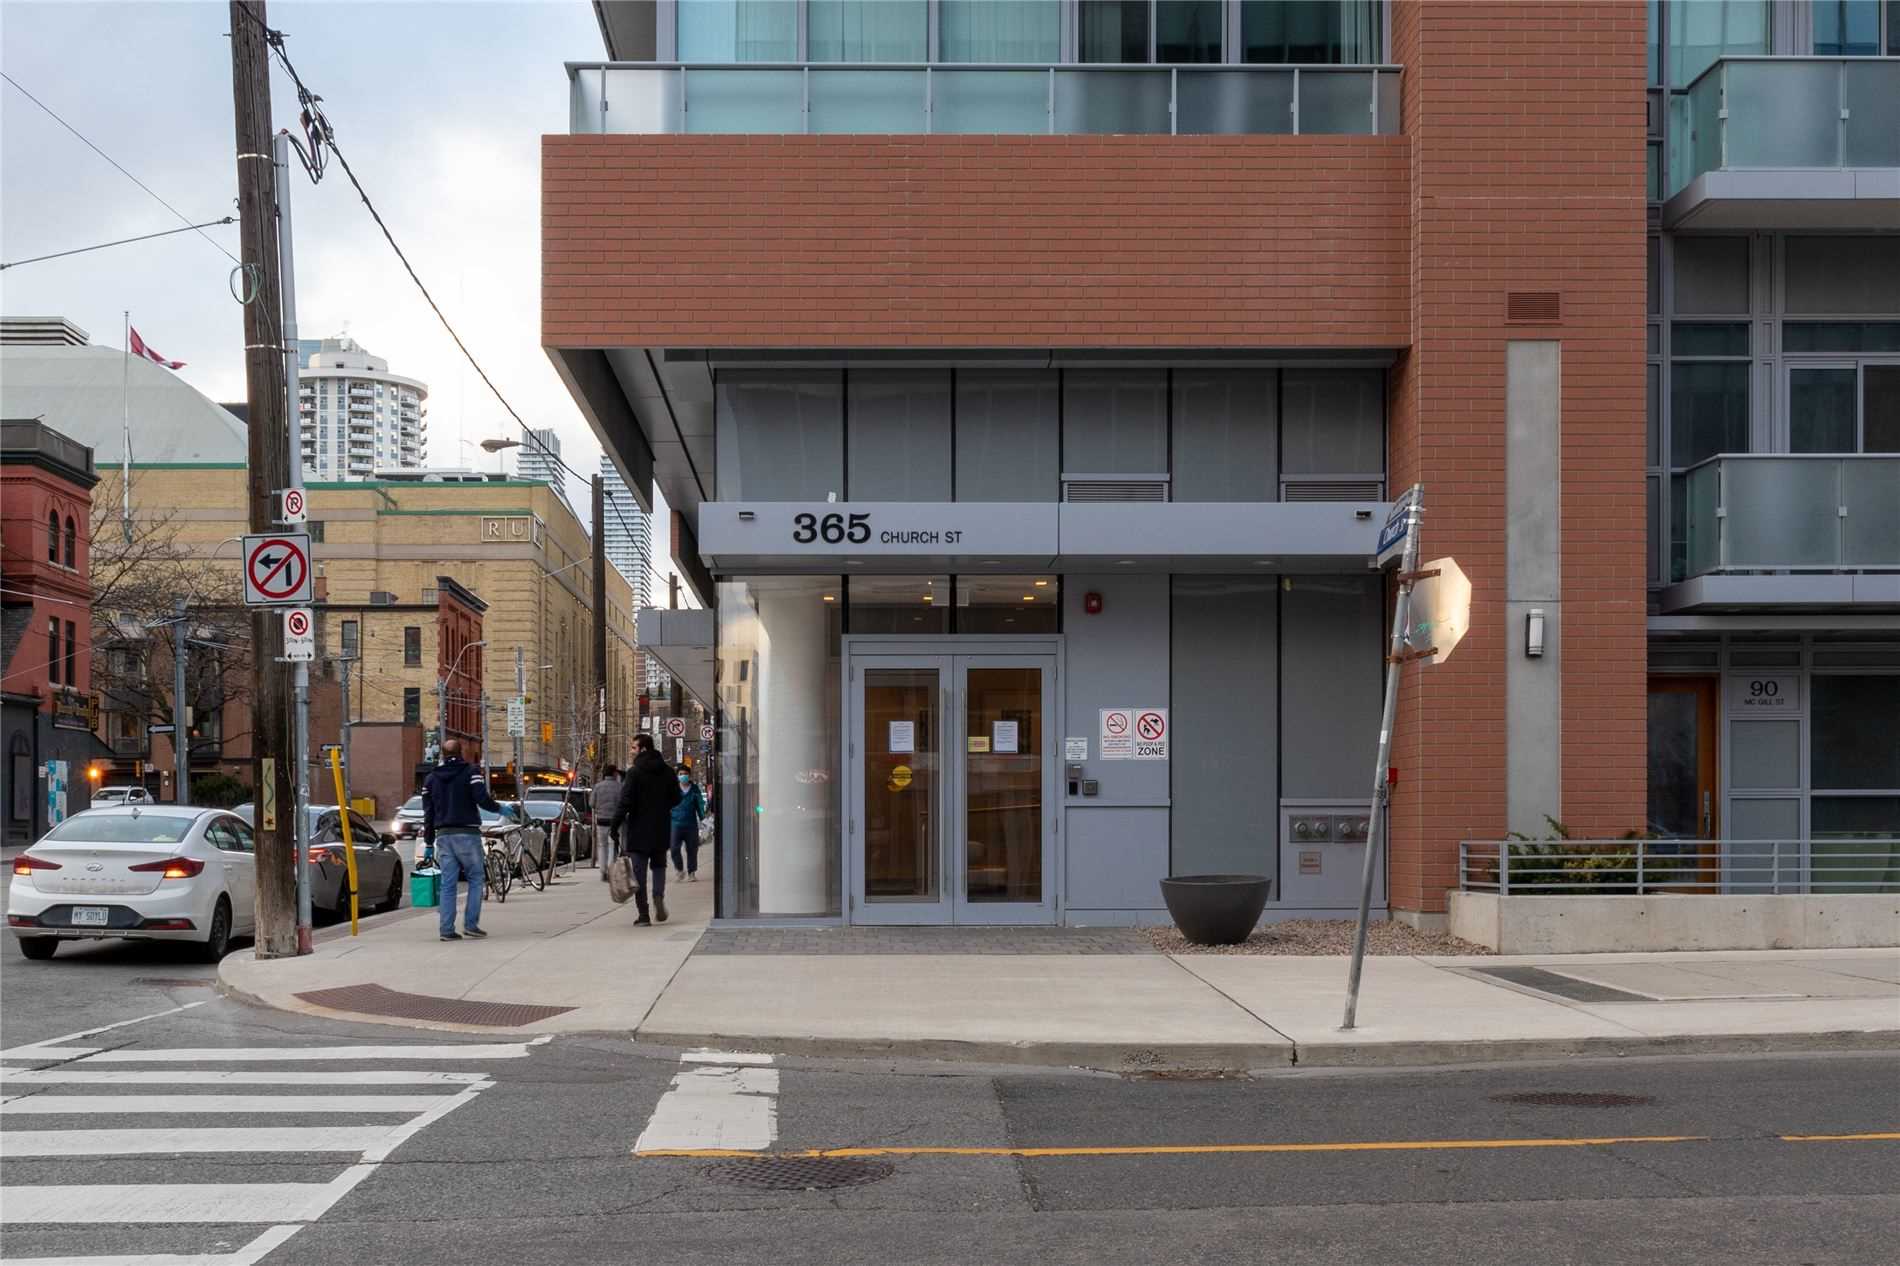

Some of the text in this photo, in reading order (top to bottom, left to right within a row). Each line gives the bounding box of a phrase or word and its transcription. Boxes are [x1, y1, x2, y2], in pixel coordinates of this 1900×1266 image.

[792, 513, 963, 544] 365 CHURCH ST
[1750, 680, 1778, 697] 90
[1138, 747, 1165, 756] ZONE
